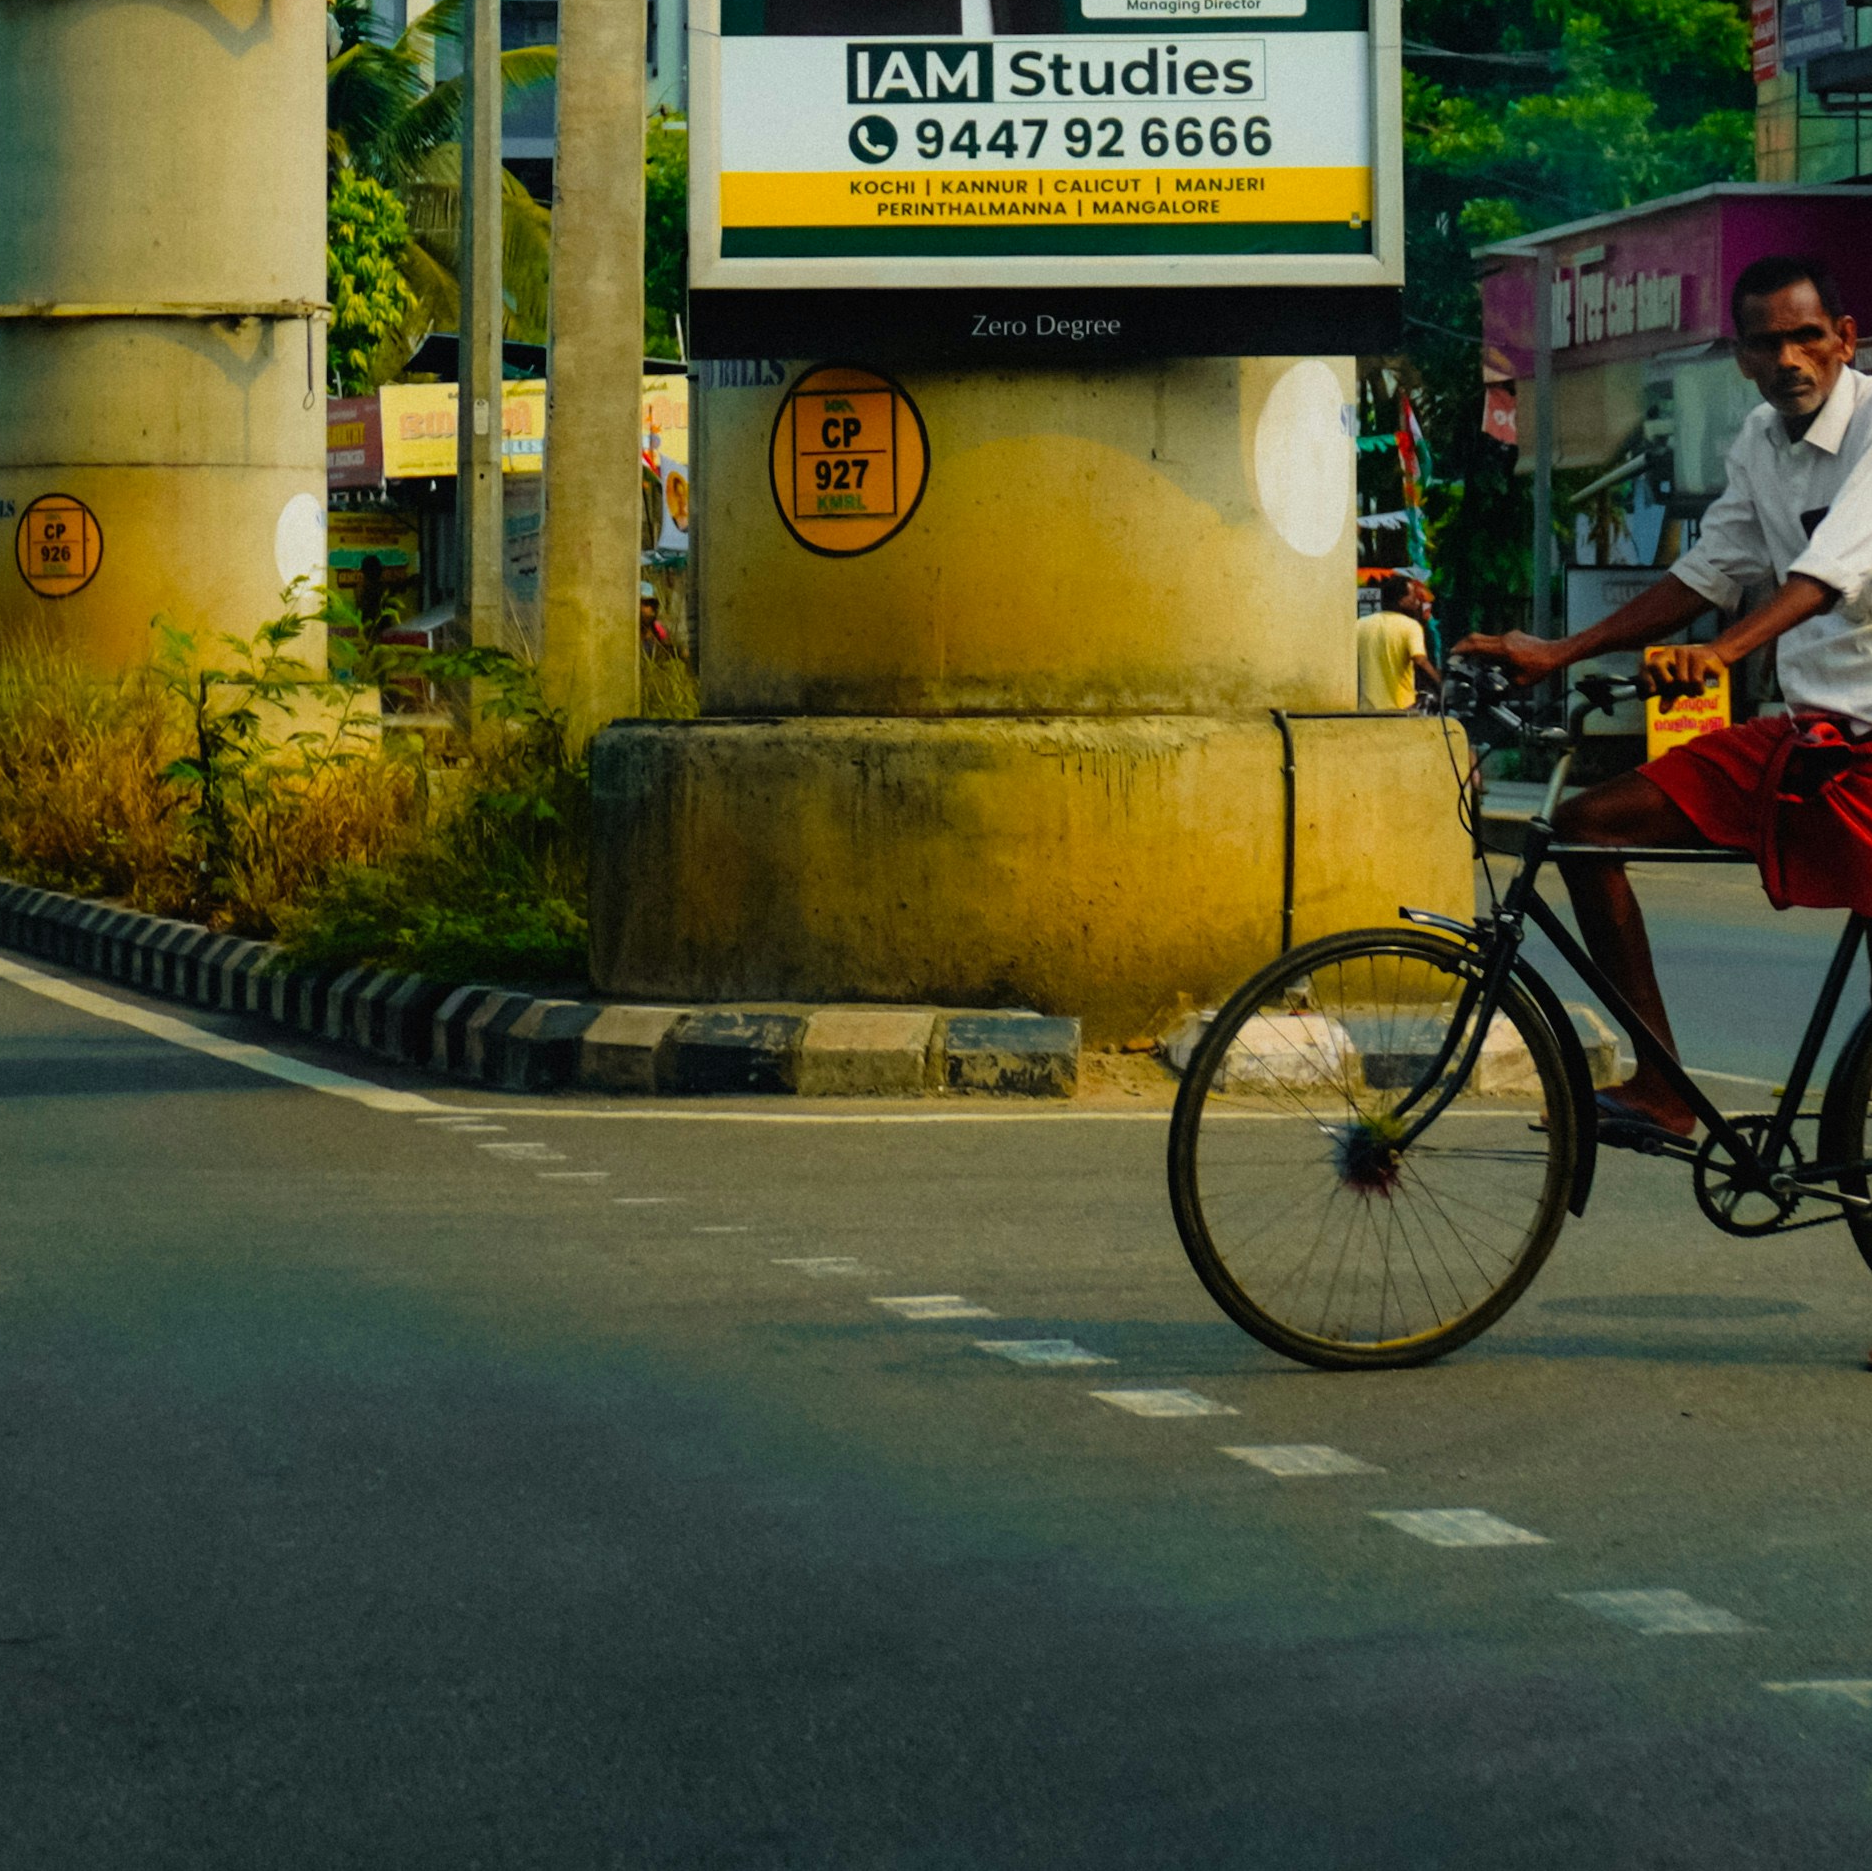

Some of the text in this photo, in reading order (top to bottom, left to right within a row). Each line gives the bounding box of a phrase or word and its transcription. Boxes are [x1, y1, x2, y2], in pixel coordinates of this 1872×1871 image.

[855, 44, 1254, 100] IAM Studies
[915, 115, 1273, 160] 9447 92 6666
[849, 177, 1266, 196] KOCHI KANNUR CALICUT MANJERI
[877, 199, 1220, 217] PERINTHALMANNA MANGALORE
[971, 314, 1122, 341] Zero Degree
[821, 417, 862, 449] CP
[815, 459, 869, 491] 927
[44, 523, 67, 542] CP
[40, 545, 72, 563] 926
